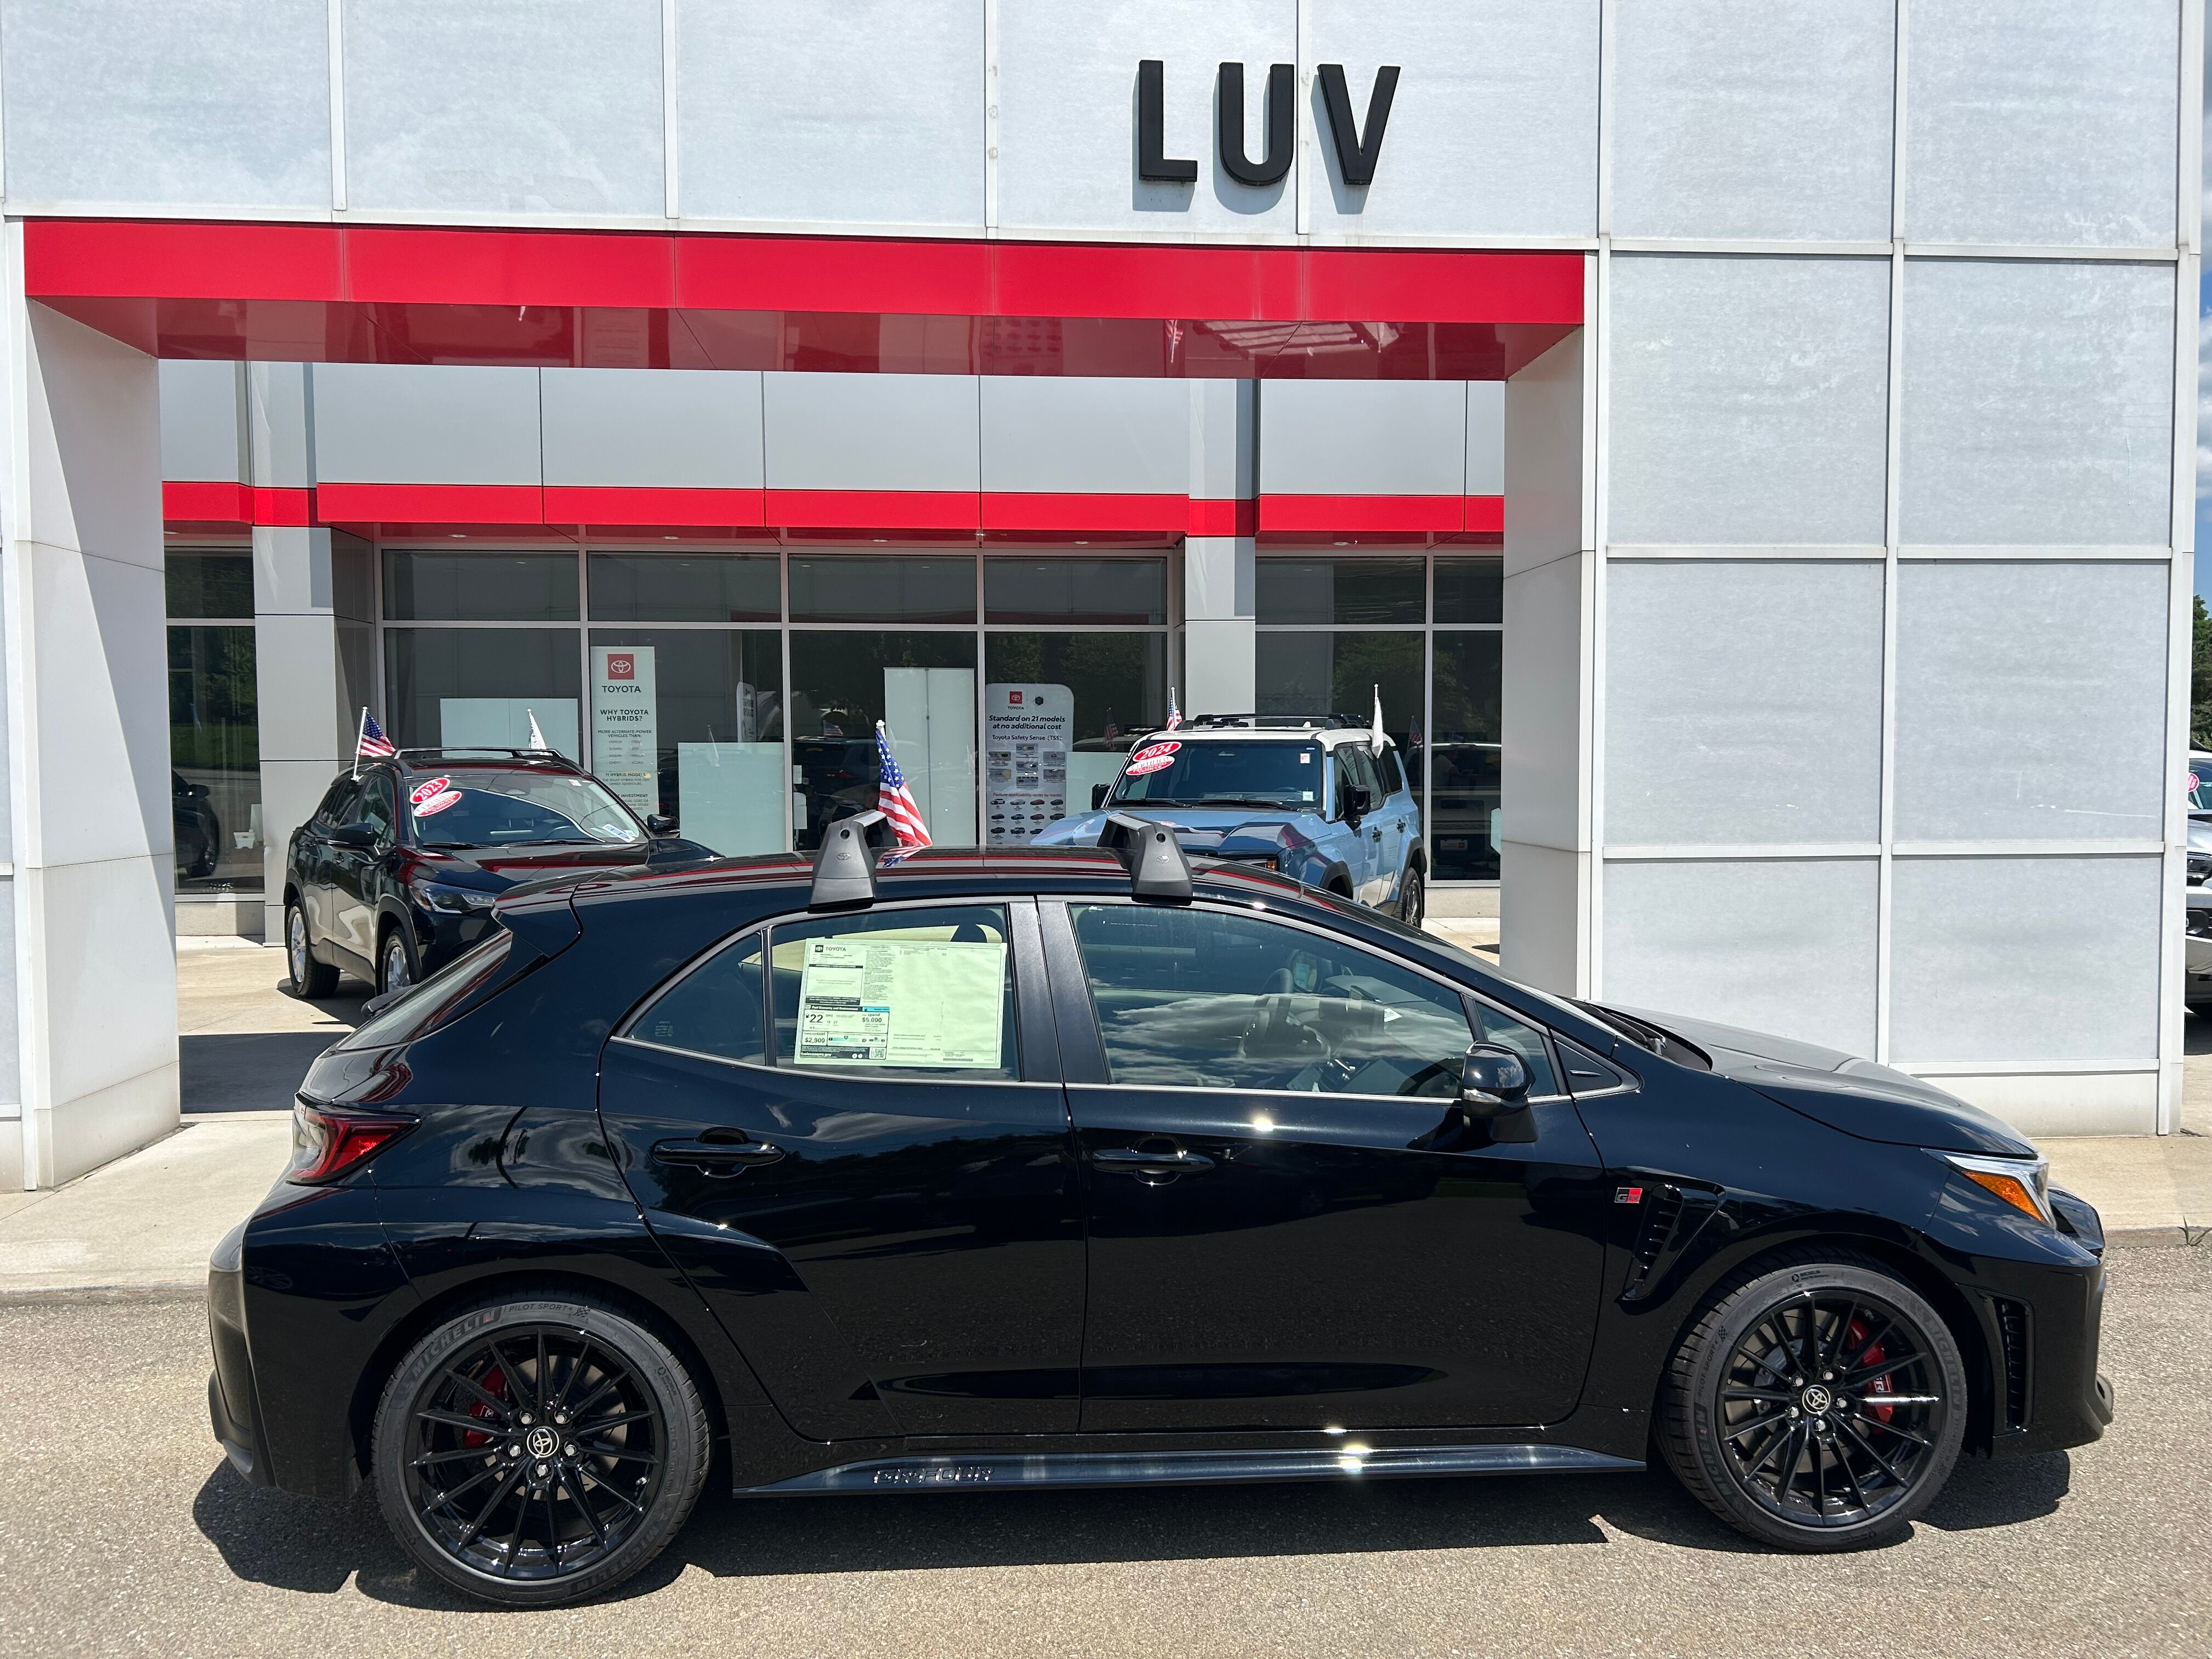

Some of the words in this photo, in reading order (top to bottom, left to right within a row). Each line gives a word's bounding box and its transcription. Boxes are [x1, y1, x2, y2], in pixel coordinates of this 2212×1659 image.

[1138, 59, 1401, 187] LUV
[1139, 743, 1173, 760] 2024
[415, 781, 443, 801] 2023
[809, 1014, 823, 1024] 22
[1616, 1193, 1640, 1203] GR
[509, 1303, 536, 1312] PILOT
[538, 1303, 567, 1311] SPORT
[411, 1310, 495, 1379] MICHELIN
[1697, 1373, 1706, 1397] PILOT
[1703, 1345, 1717, 1374] SPORT
[1926, 1319, 1961, 1406] MICHELIN
